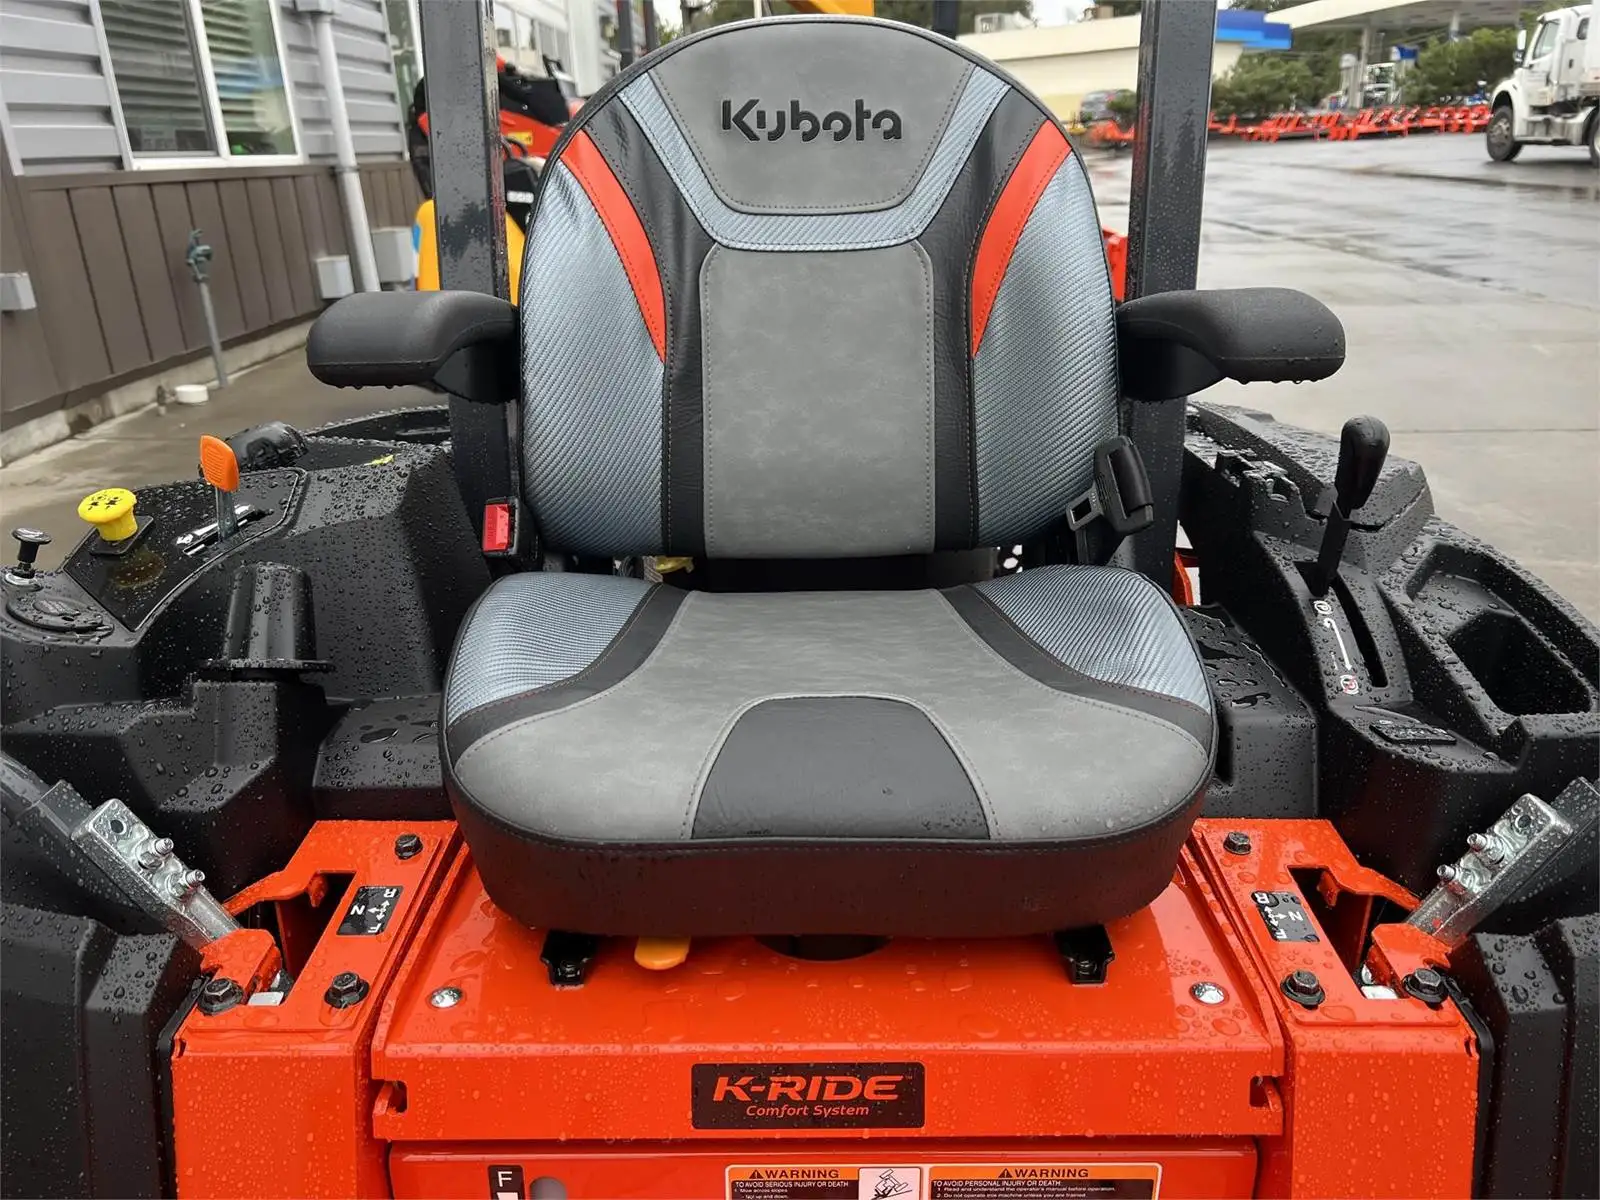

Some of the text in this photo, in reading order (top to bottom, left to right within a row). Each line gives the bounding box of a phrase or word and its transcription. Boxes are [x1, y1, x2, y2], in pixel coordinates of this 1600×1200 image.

[722, 99, 902, 142] Kubota
[384, 889, 397, 898] R
[1254, 893, 1270, 904] R
[351, 905, 366, 915] N
[1287, 911, 1304, 921] N
[368, 923, 381, 933] F
[1276, 929, 1288, 939] F
[712, 1075, 904, 1101] K-RIDE
[746, 1104, 869, 1119] Comfort System
[764, 1169, 840, 1179] WARNING
[1014, 1168, 1089, 1178] WARNING
[498, 1171, 513, 1187] F
